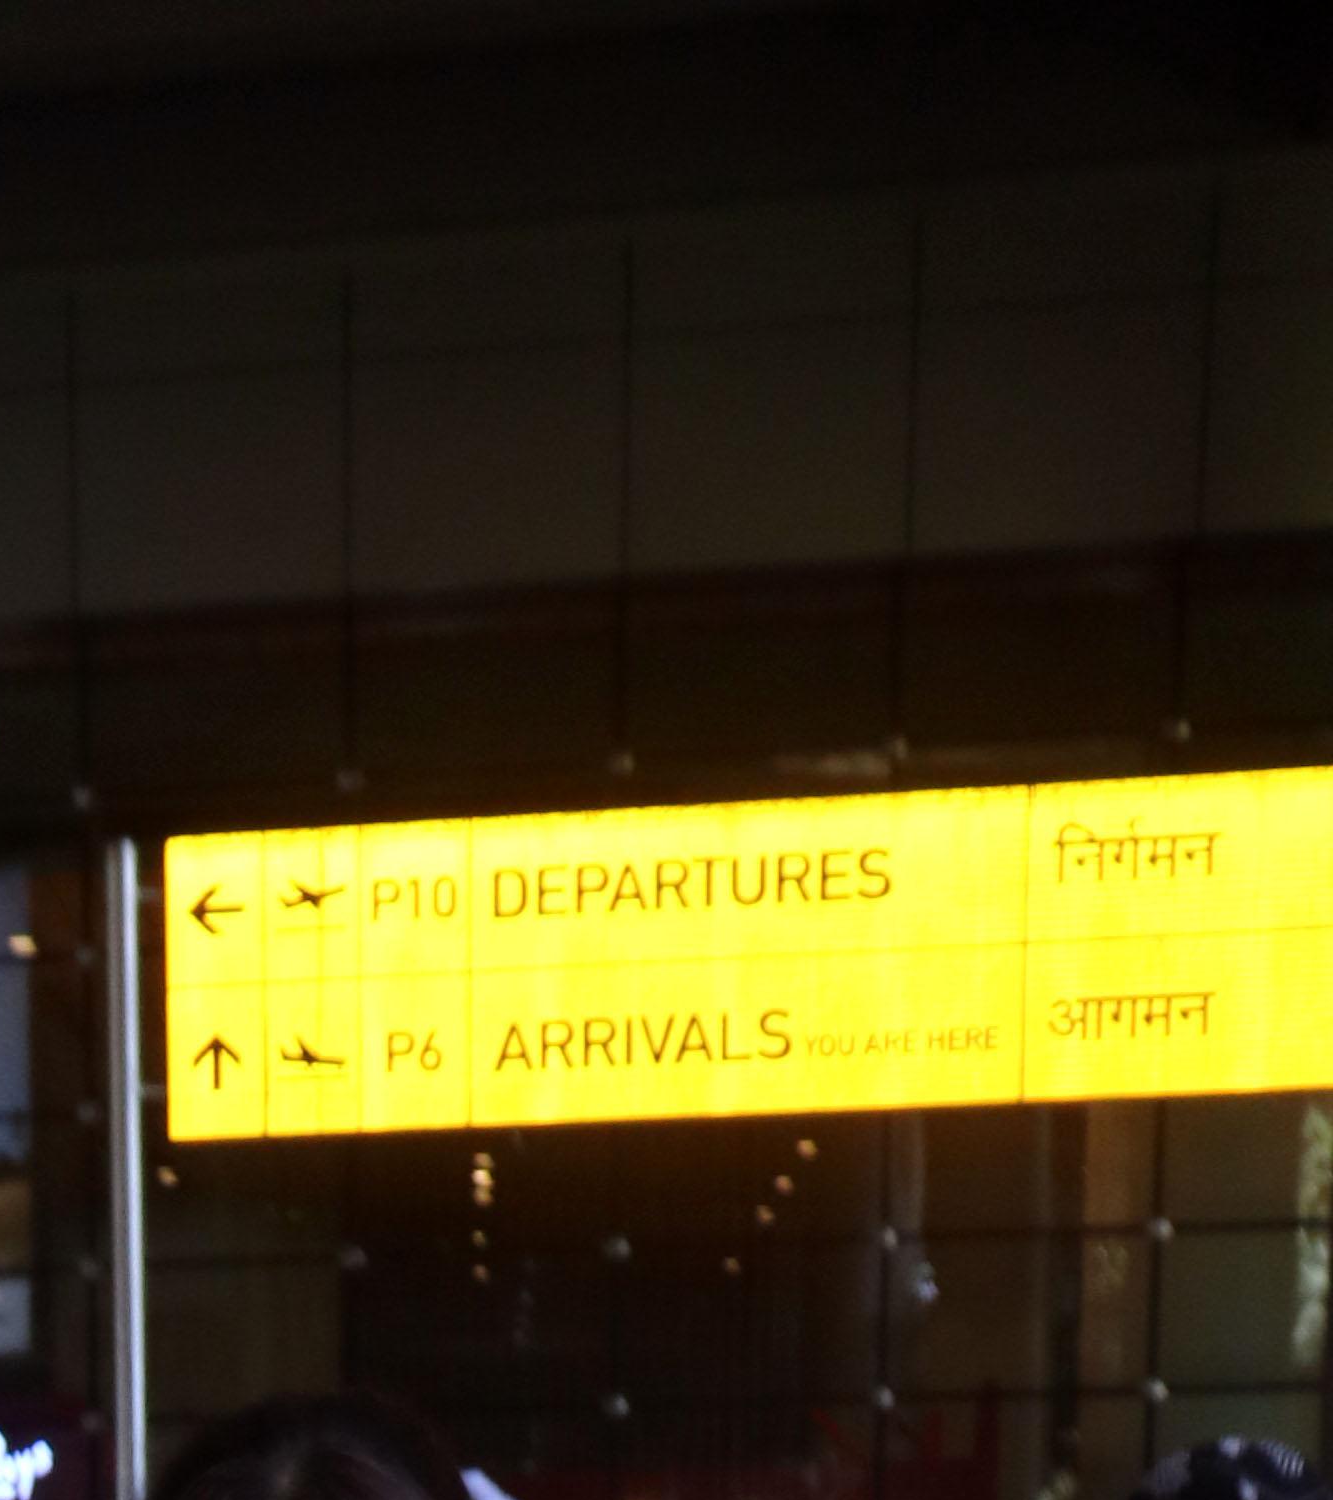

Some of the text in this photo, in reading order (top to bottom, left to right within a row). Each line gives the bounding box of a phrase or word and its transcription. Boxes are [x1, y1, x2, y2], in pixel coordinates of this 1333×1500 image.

[1053, 815, 1221, 883] निर्गमन
[372, 848, 892, 921] P10 DEPARTURES
[386, 1007, 1000, 1072] P6 ARRIVALS YOU ARE HERE
[1048, 991, 1216, 1040] आगमन
